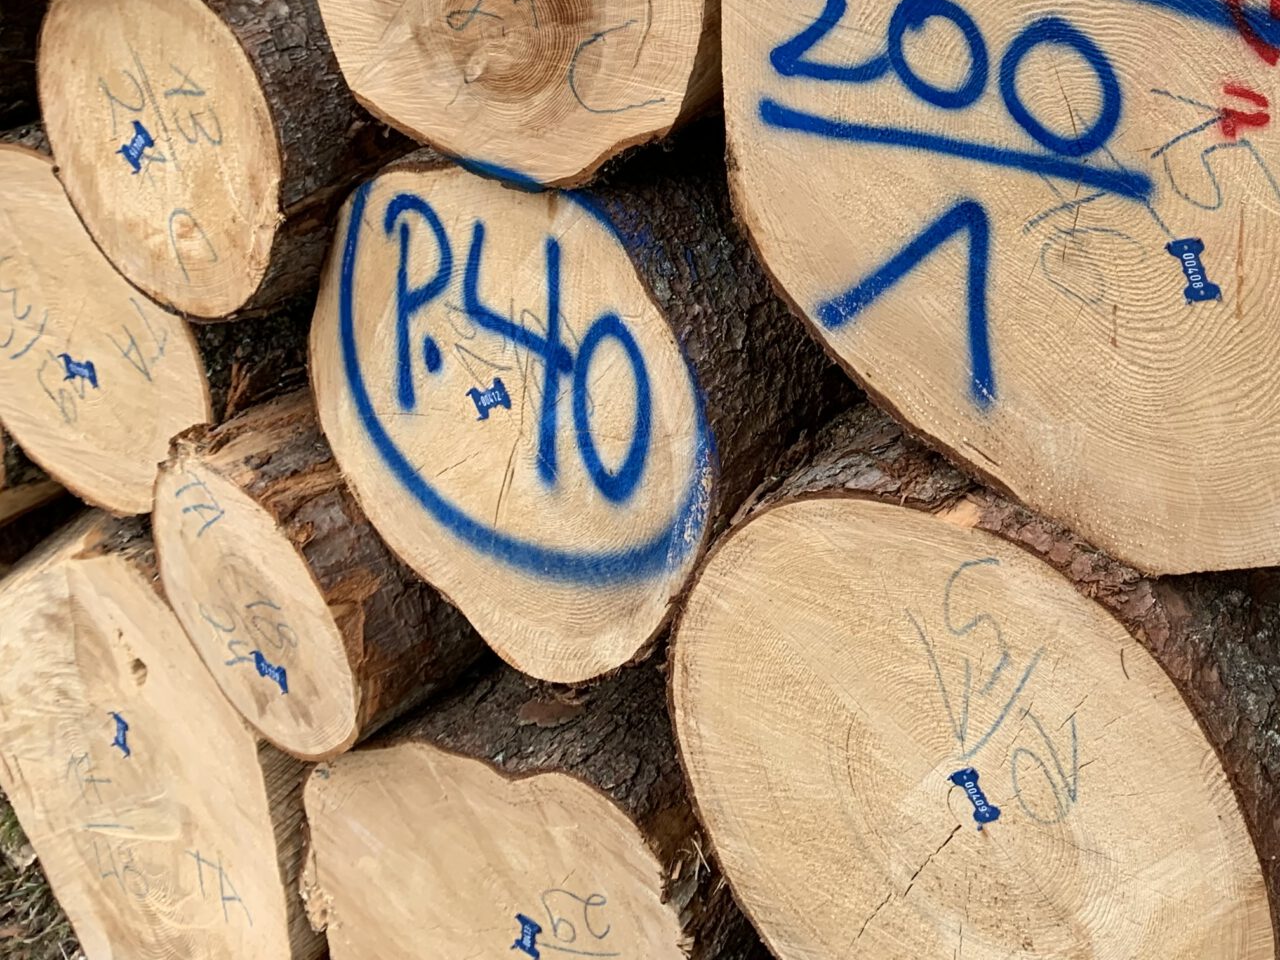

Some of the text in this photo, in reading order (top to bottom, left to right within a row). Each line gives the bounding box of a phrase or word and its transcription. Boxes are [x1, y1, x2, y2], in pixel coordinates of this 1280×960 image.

[1182, 250, 1201, 291] 00408
[816, 197, 995, 407] 1
[384, 193, 651, 505] P.40
[480, 391, 502, 407] 00412
[963, 780, 989, 814] 00409
[541, 888, 611, 943] 29
